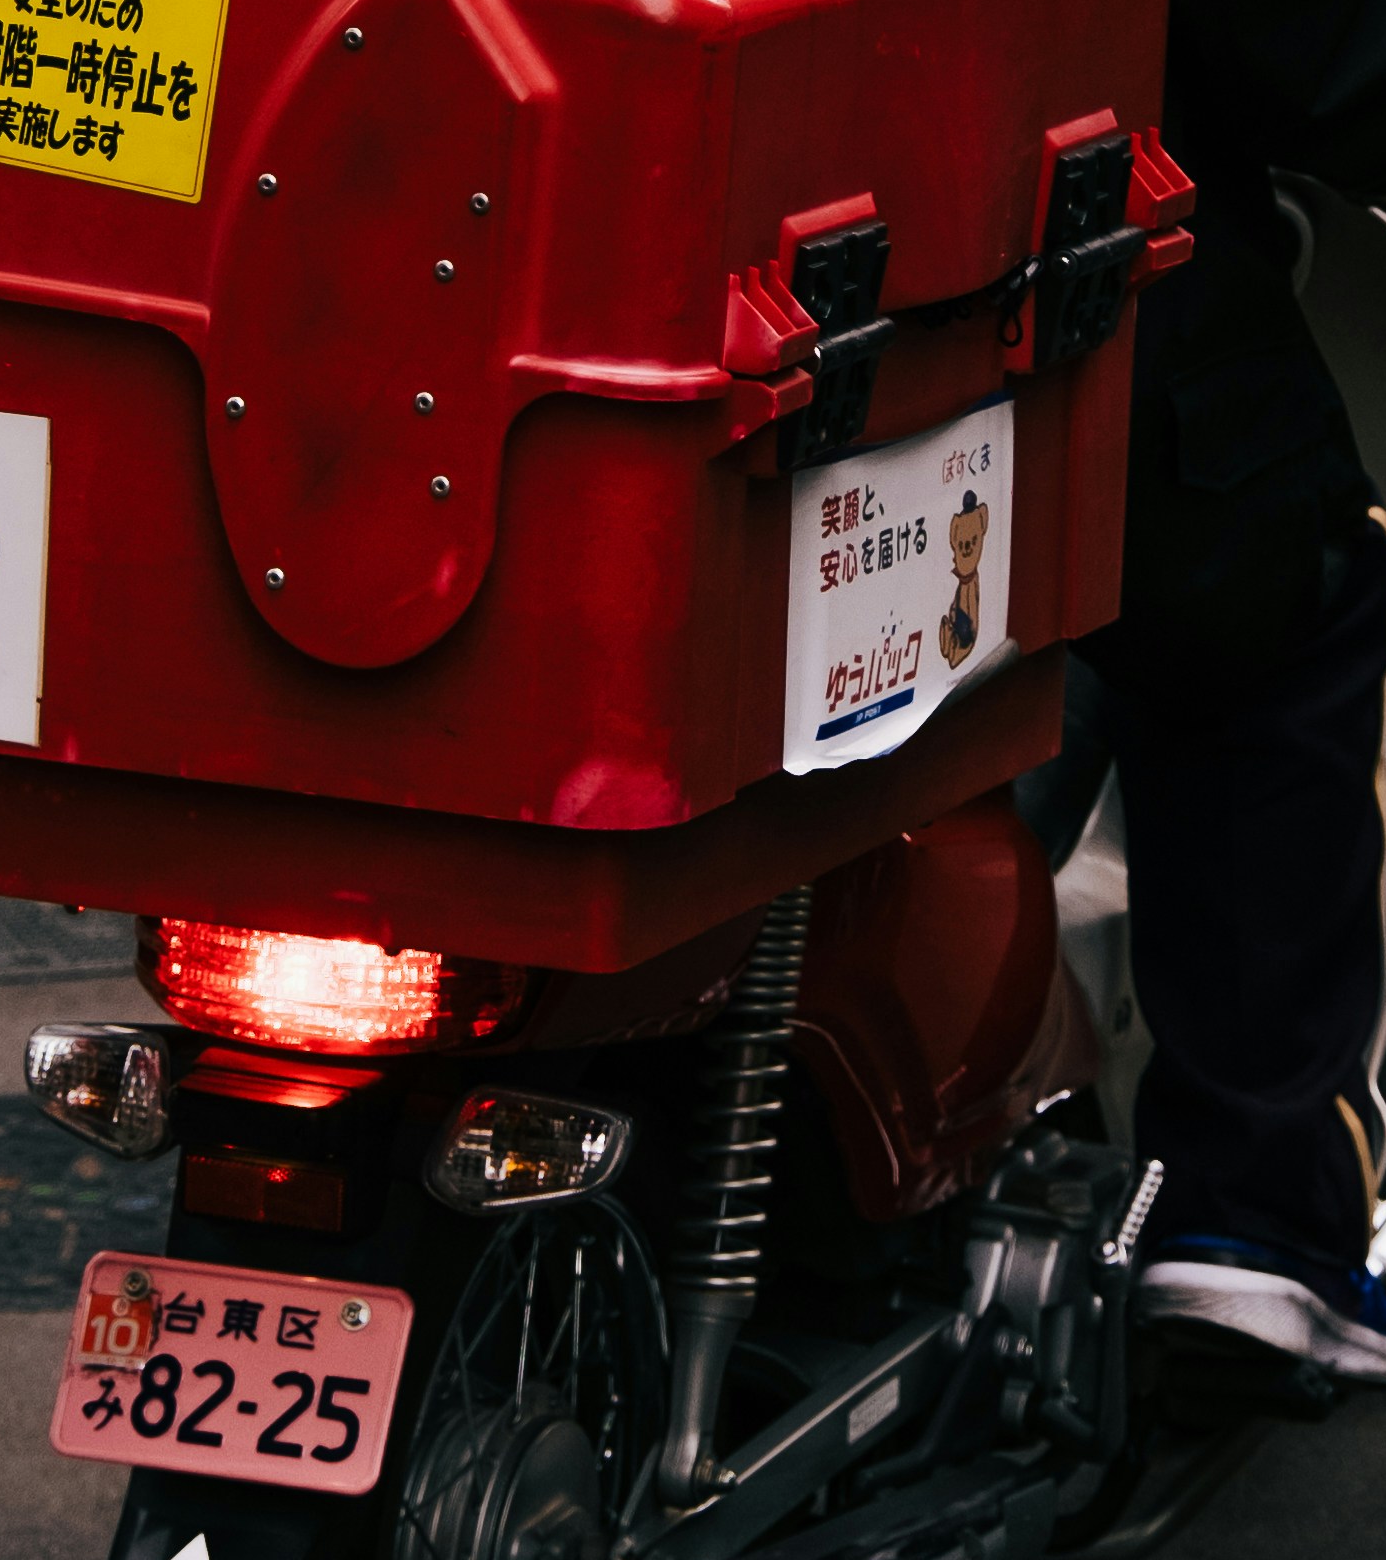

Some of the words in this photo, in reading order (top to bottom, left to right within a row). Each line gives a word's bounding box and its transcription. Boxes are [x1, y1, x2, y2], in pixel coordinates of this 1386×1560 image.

[820, 483, 885, 539] 笑顔と、
[819, 516, 928, 593] 安心を届ける
[825, 628, 923, 714] ゆうパック
[91, 1314, 141, 1356] 10
[164, 1291, 321, 1351] 台東区
